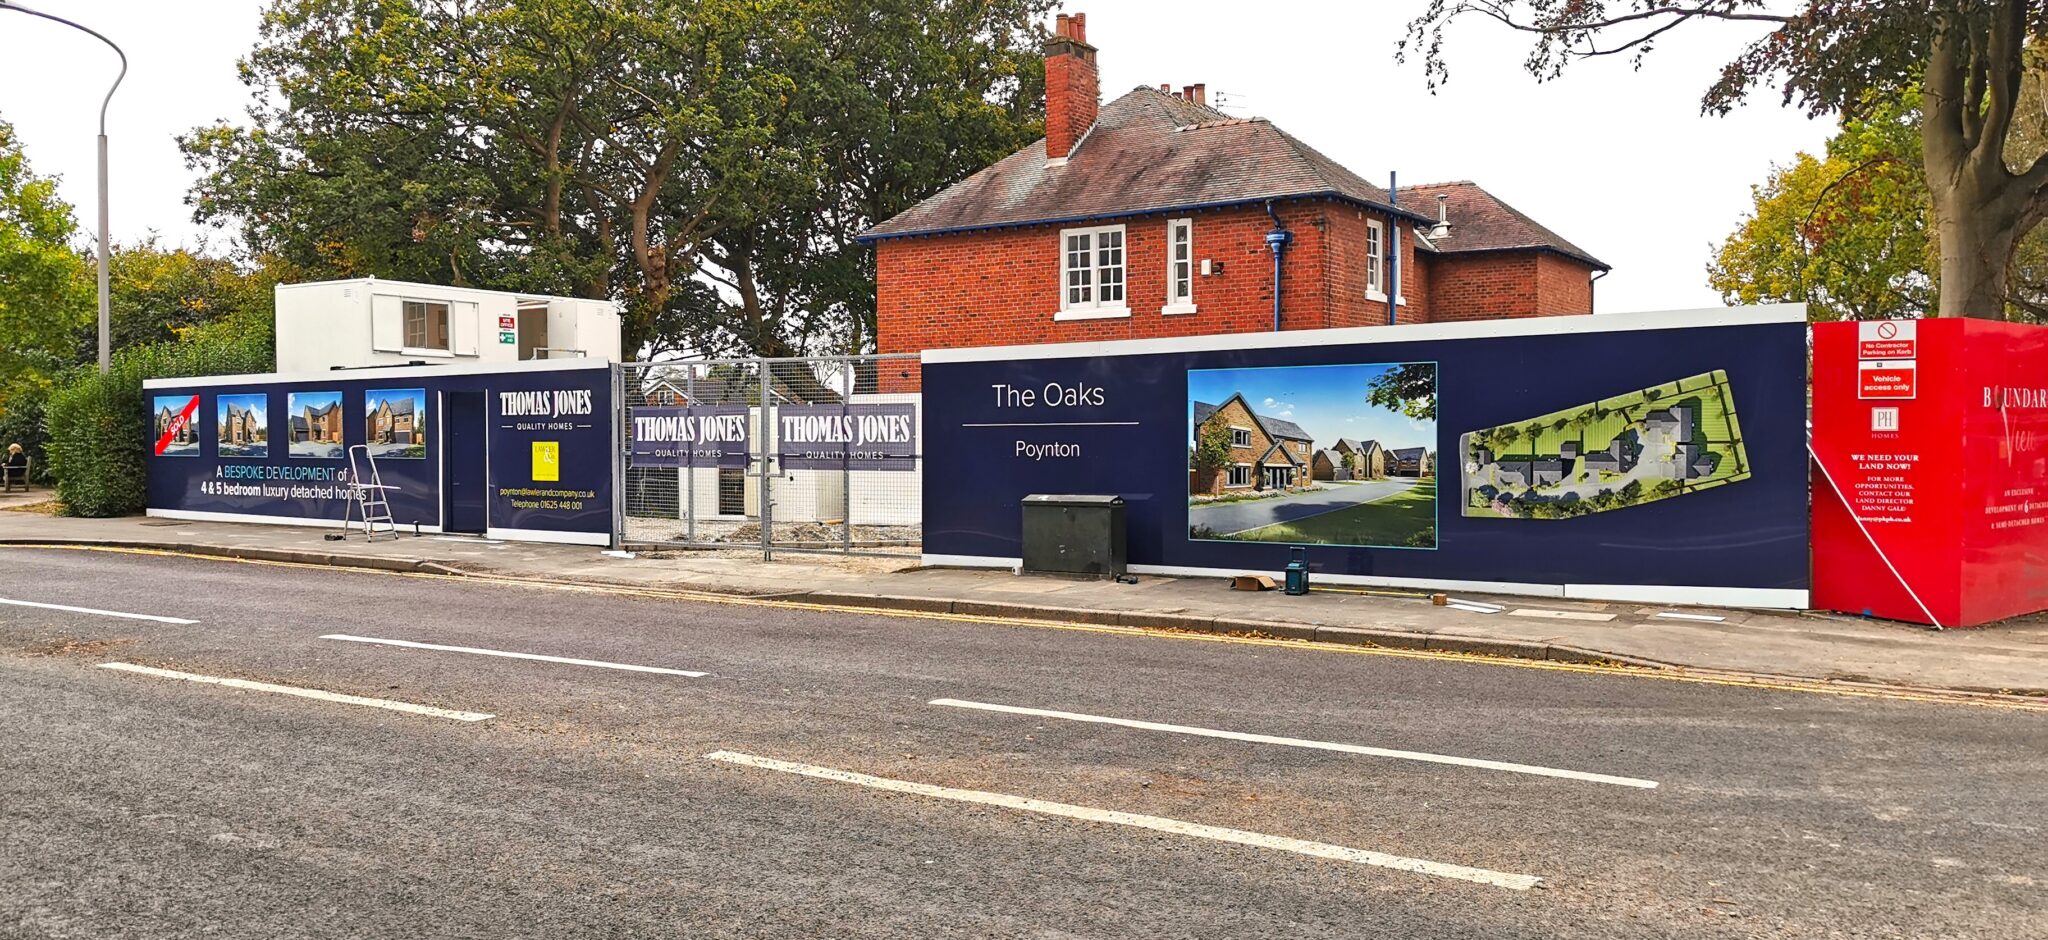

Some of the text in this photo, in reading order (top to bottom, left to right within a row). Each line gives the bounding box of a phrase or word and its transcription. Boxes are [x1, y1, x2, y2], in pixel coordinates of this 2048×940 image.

[1872, 375, 1902, 383] Vehicle
[992, 382, 1105, 408] The Oaks
[1893, 384, 1910, 392] only
[500, 389, 592, 419] THOMAS JONES
[1983, 384, 2048, 410] BOUNDAR
[170, 415, 185, 436] SOLD
[516, 421, 574, 430] QUALITY HOMES
[1877, 411, 1892, 427] PH
[634, 414, 746, 445] THOMAS JONES
[781, 414, 910, 447] THOMAS JONES
[654, 448, 722, 459] QUALITY HOMES
[805, 450, 884, 460] QUALITY HOMES
[1015, 440, 1081, 461] Poynton
[216, 465, 348, 482] A BESPOKE DEVELOPMENT of
[201, 481, 367, 501] 4 & 5 bedroom luxury detached homes
[499, 488, 595, 499] poynton@lawlerandcompany.co.uk
[511, 499, 539, 509] Telephone
[540, 500, 558, 509] 01625
[571, 502, 583, 510] 001
[1985, 504, 2017, 515] DEVELOPMENT
[2024, 500, 2029, 513] 6
